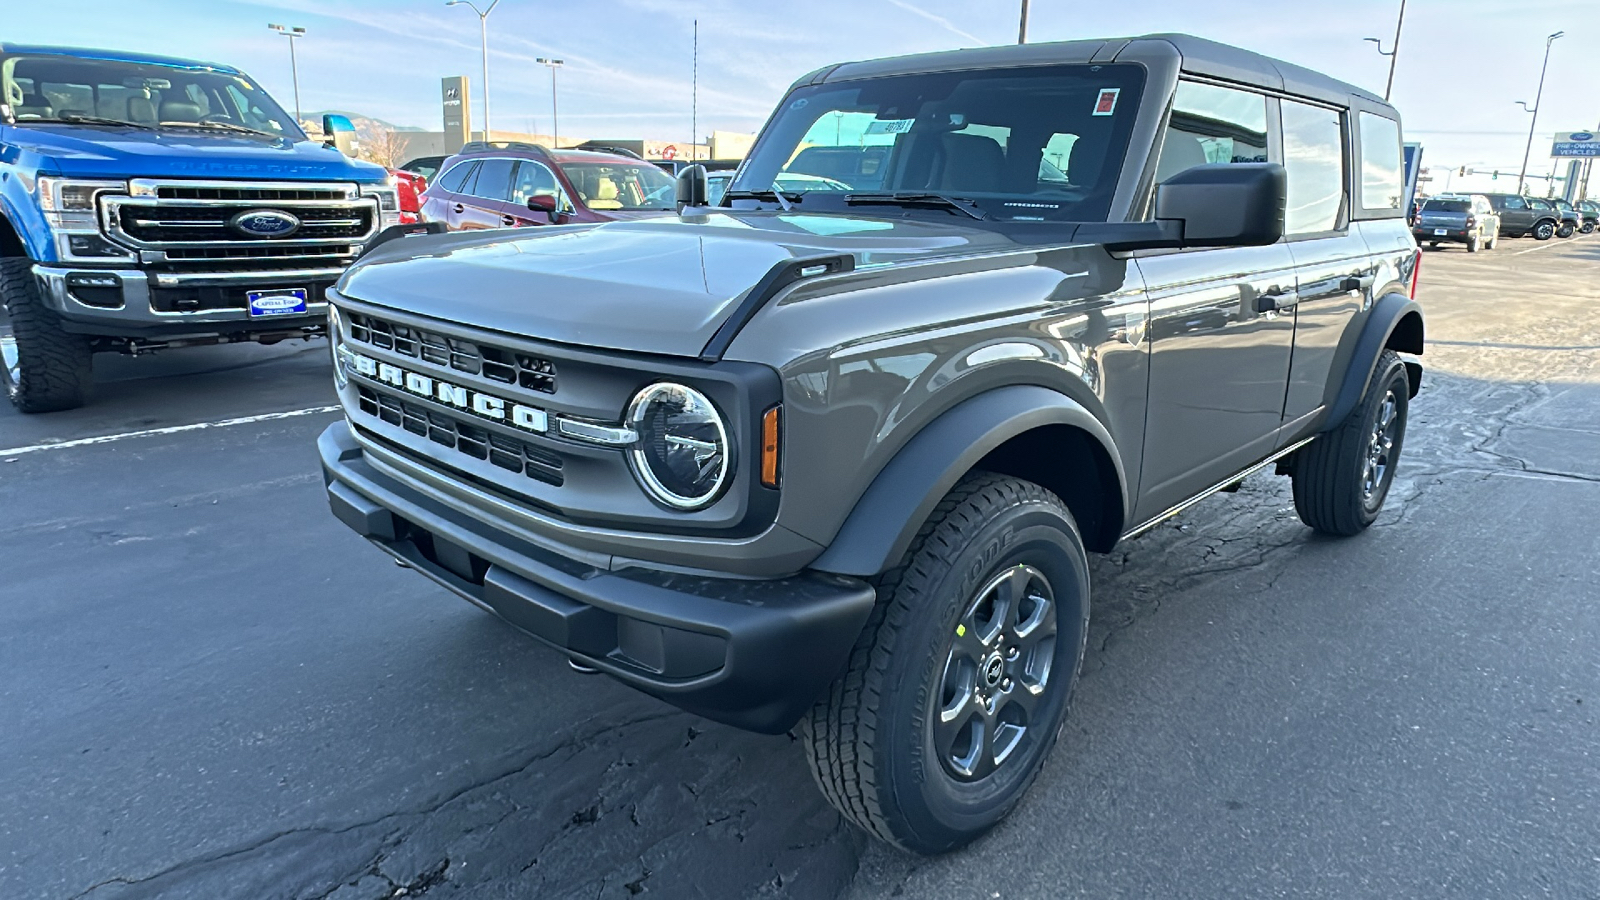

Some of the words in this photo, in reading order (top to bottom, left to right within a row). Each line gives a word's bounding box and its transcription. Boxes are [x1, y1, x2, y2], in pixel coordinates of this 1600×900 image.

[267, 164, 327, 174] DUTY
[252, 216, 284, 230] Ford
[355, 353, 549, 433] BRONCO
